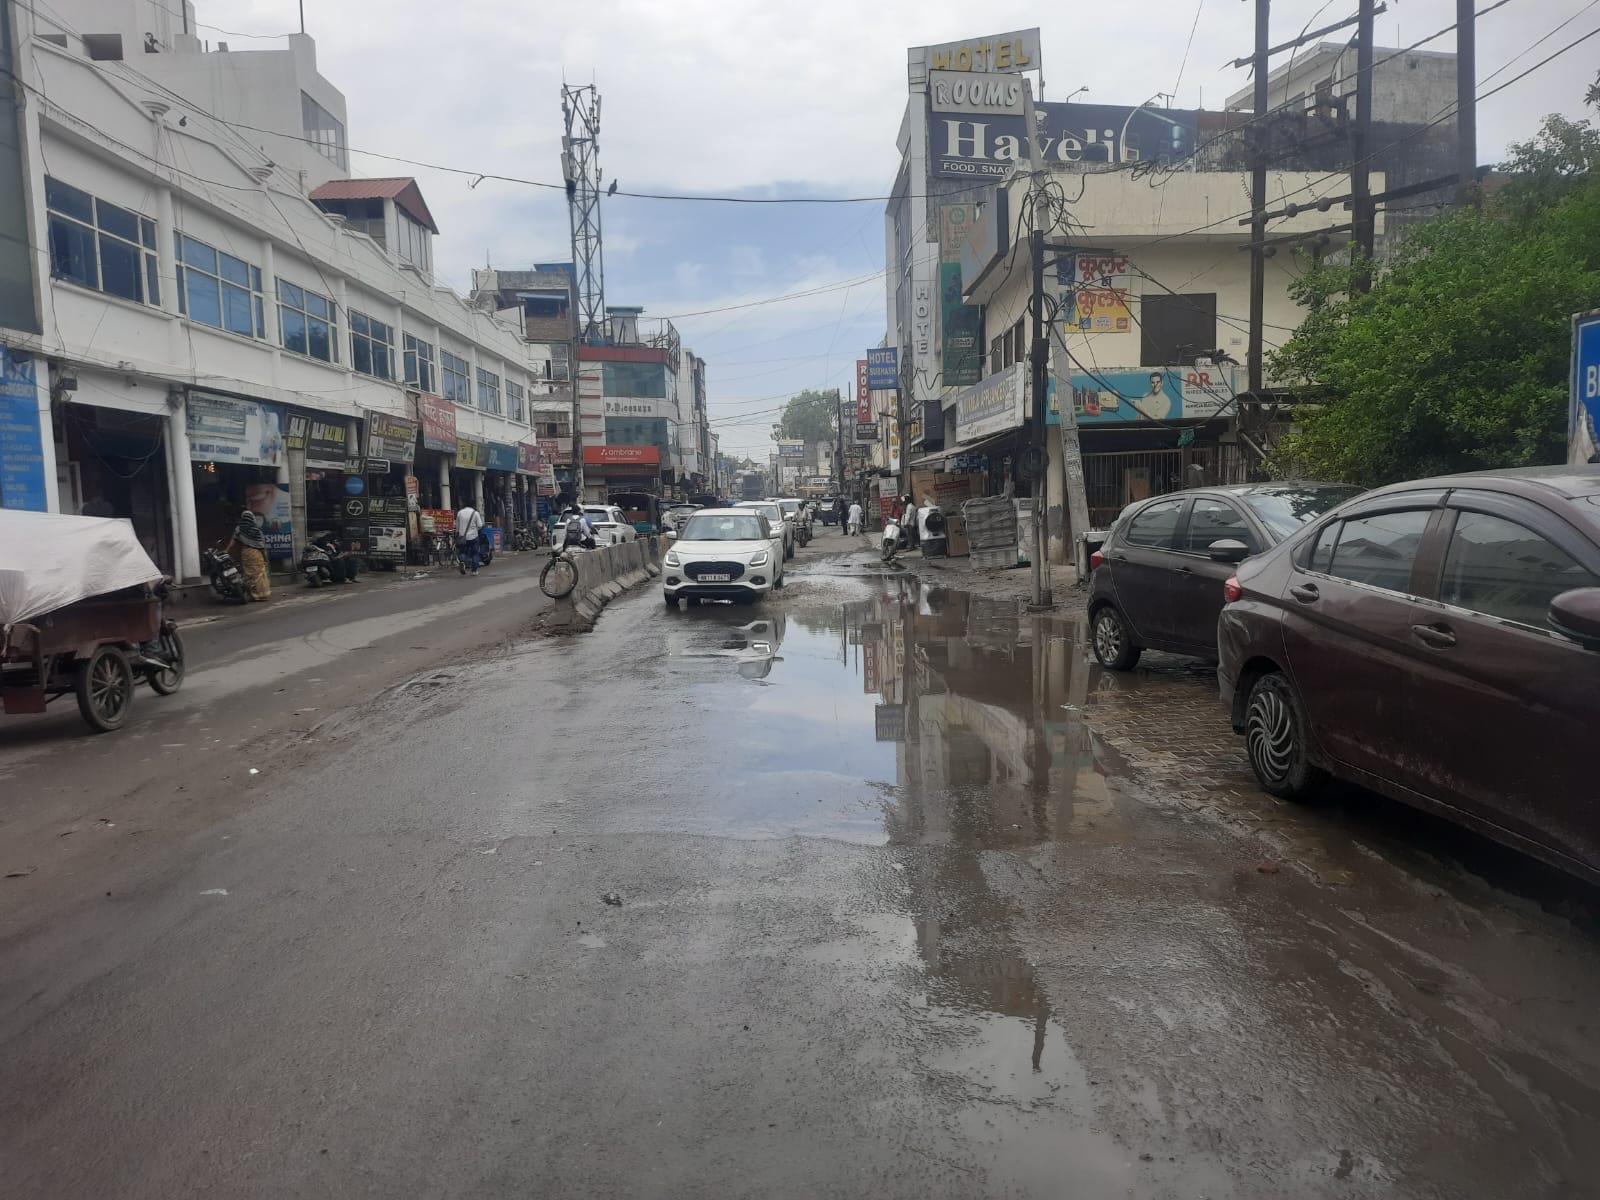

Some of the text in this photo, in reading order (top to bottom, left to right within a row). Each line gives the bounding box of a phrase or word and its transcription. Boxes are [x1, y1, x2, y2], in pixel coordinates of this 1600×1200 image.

[932, 38, 1031, 72] HOTEL
[935, 78, 1020, 107] ROOMS
[941, 118, 1115, 163] Haveli
[943, 161, 979, 174] FOOD,
[869, 351, 896, 364] HOTEL
[608, 448, 642, 456] ambrane
[264, 534, 292, 543] SHNA
